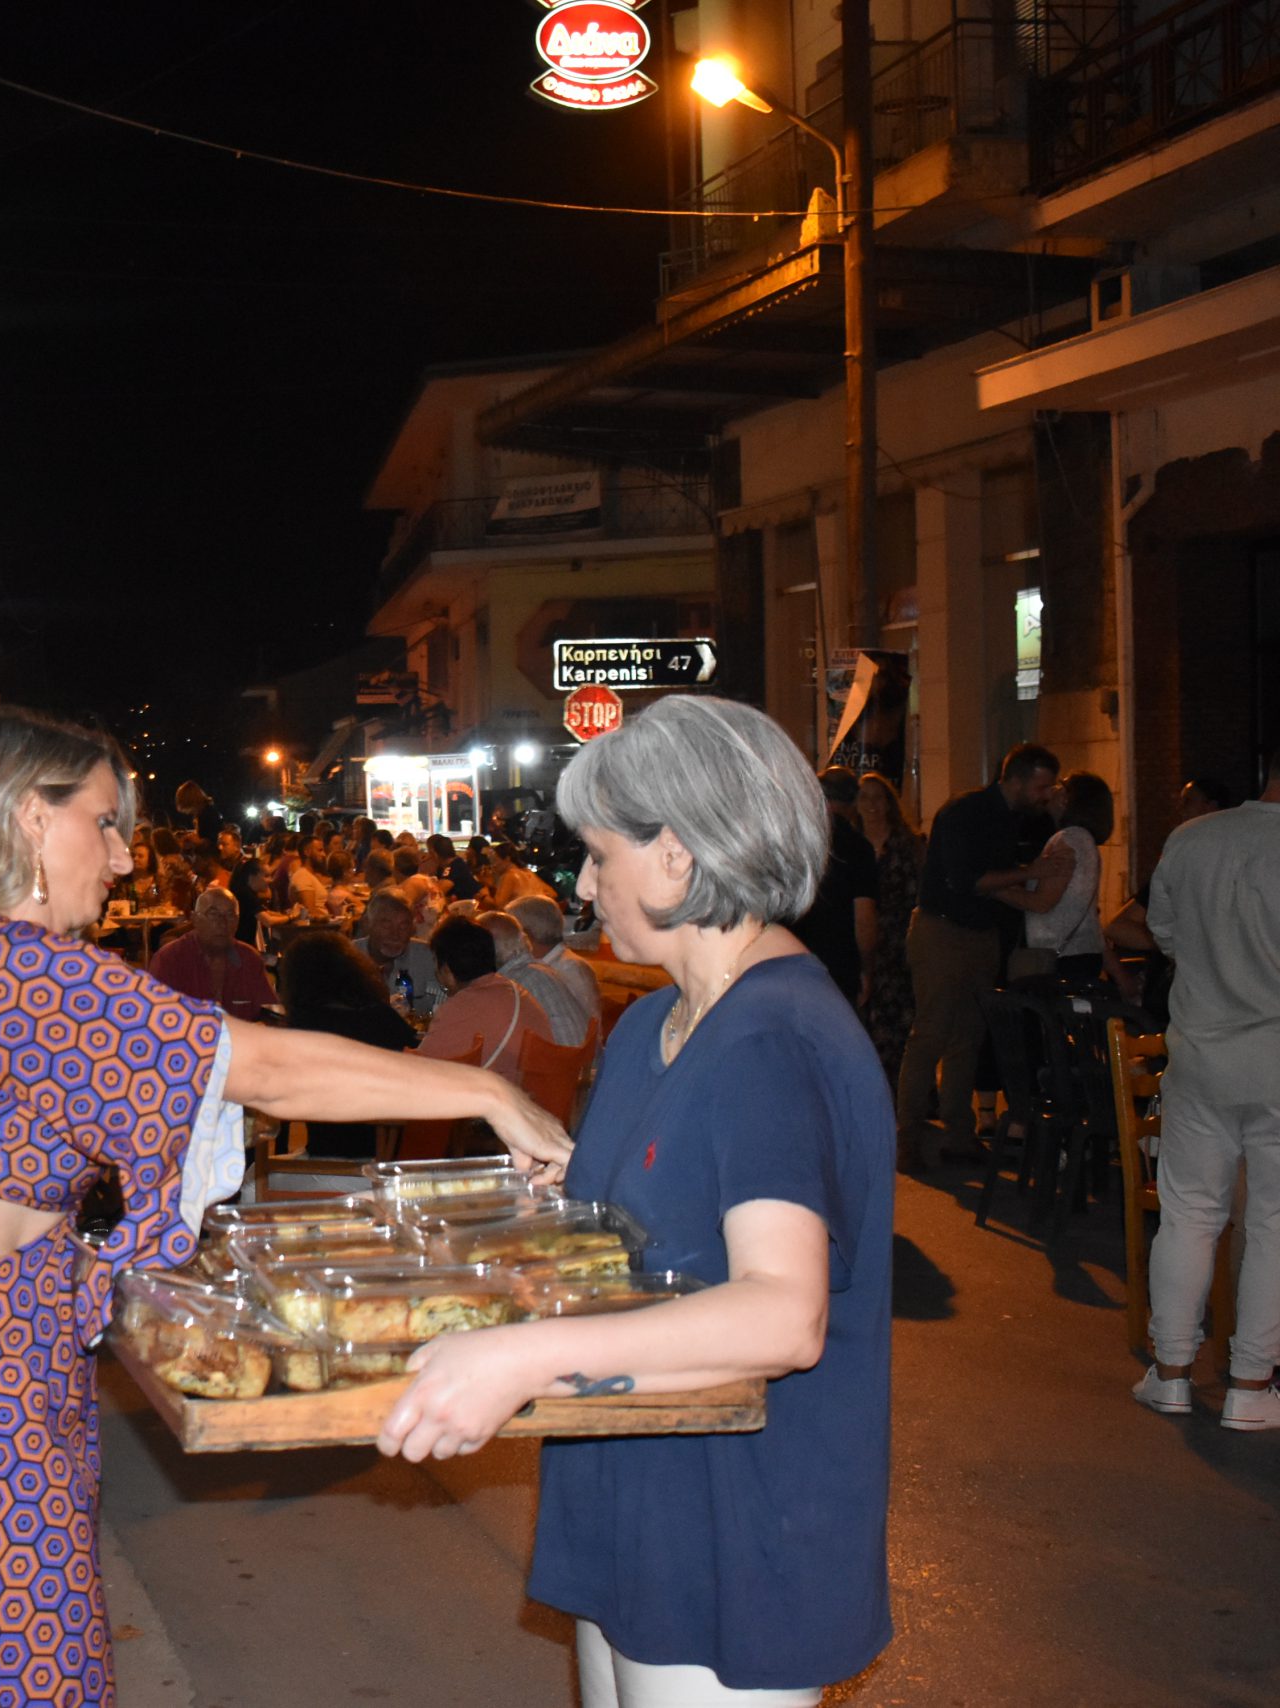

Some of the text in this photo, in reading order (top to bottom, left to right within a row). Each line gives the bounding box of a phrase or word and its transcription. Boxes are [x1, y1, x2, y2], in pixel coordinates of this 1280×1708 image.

[561, 644, 662, 665] Καρπενήσι
[667, 655, 692, 671] 47
[562, 665, 654, 684] Karpenisi
[569, 702, 618, 727] STOP
